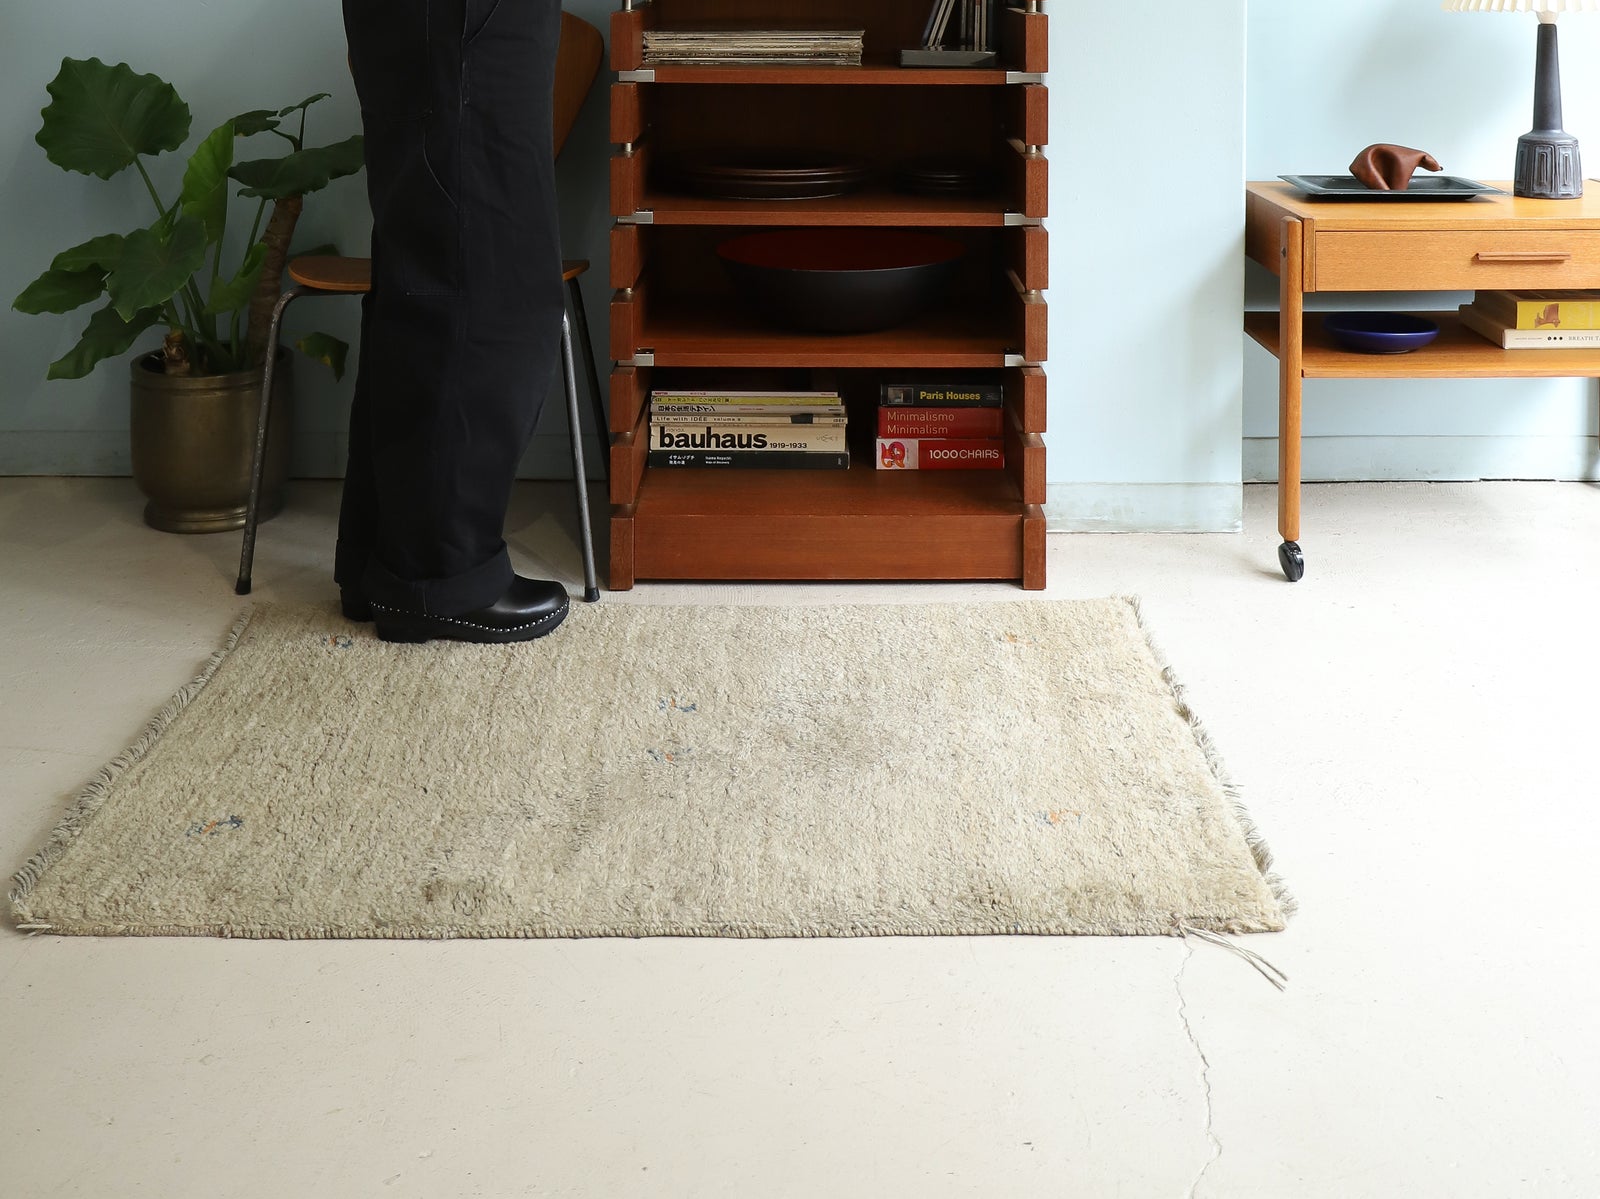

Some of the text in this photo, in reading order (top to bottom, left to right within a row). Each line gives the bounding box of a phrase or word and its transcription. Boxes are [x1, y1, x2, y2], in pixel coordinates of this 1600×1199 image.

[919, 391, 944, 400] Paris
[946, 391, 981, 400] Houses
[887, 411, 955, 422] Minimalismo
[887, 425, 949, 434] Minimalism
[659, 426, 768, 449] bauhaus
